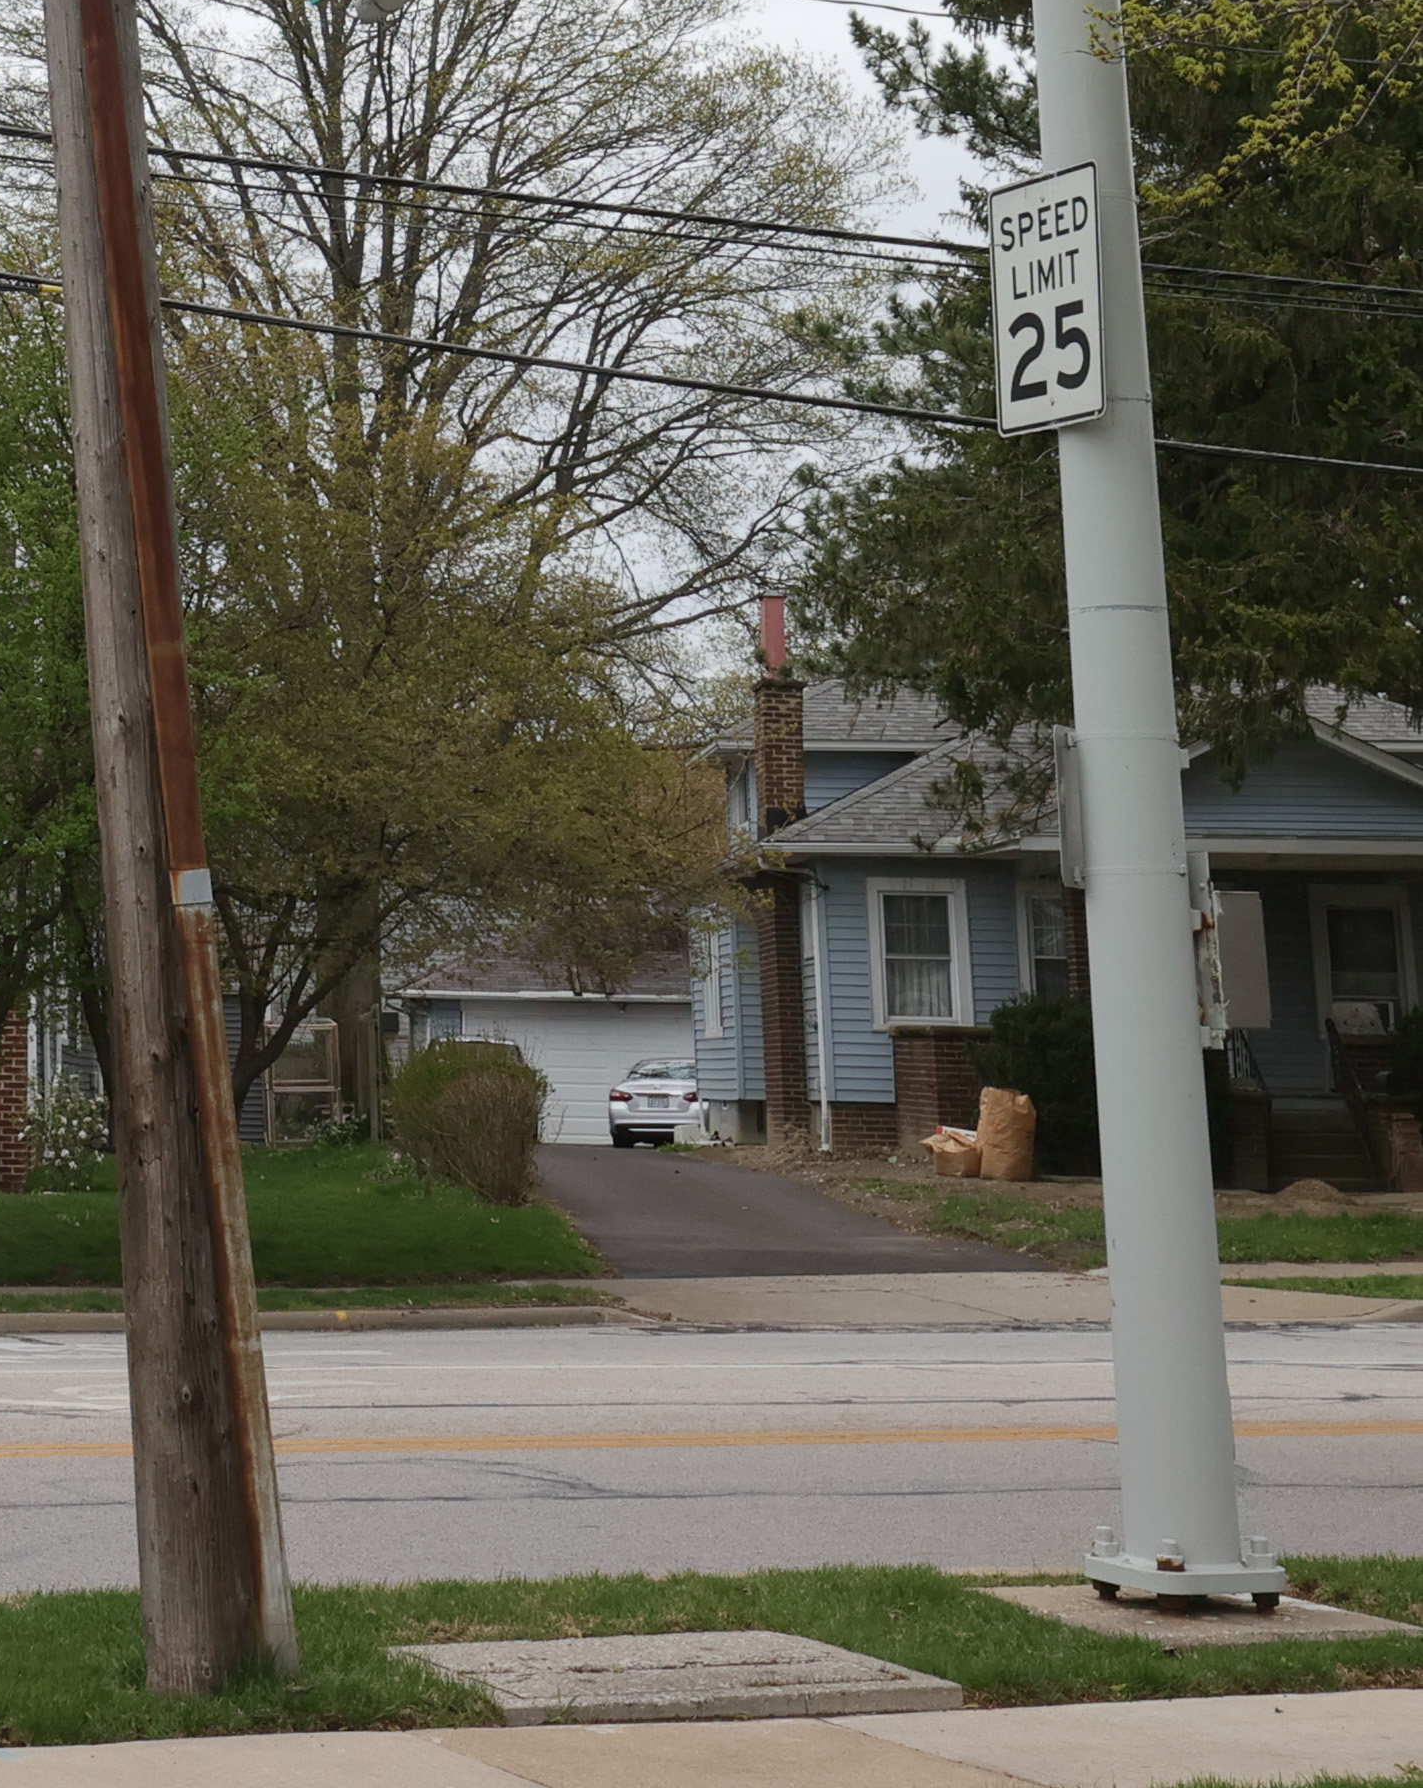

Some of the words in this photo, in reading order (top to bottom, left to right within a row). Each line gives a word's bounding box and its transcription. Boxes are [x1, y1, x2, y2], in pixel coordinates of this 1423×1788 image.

[1000, 195, 1088, 252] SPEED
[1011, 248, 1080, 301] LIMIT
[1008, 299, 1091, 403] 25
